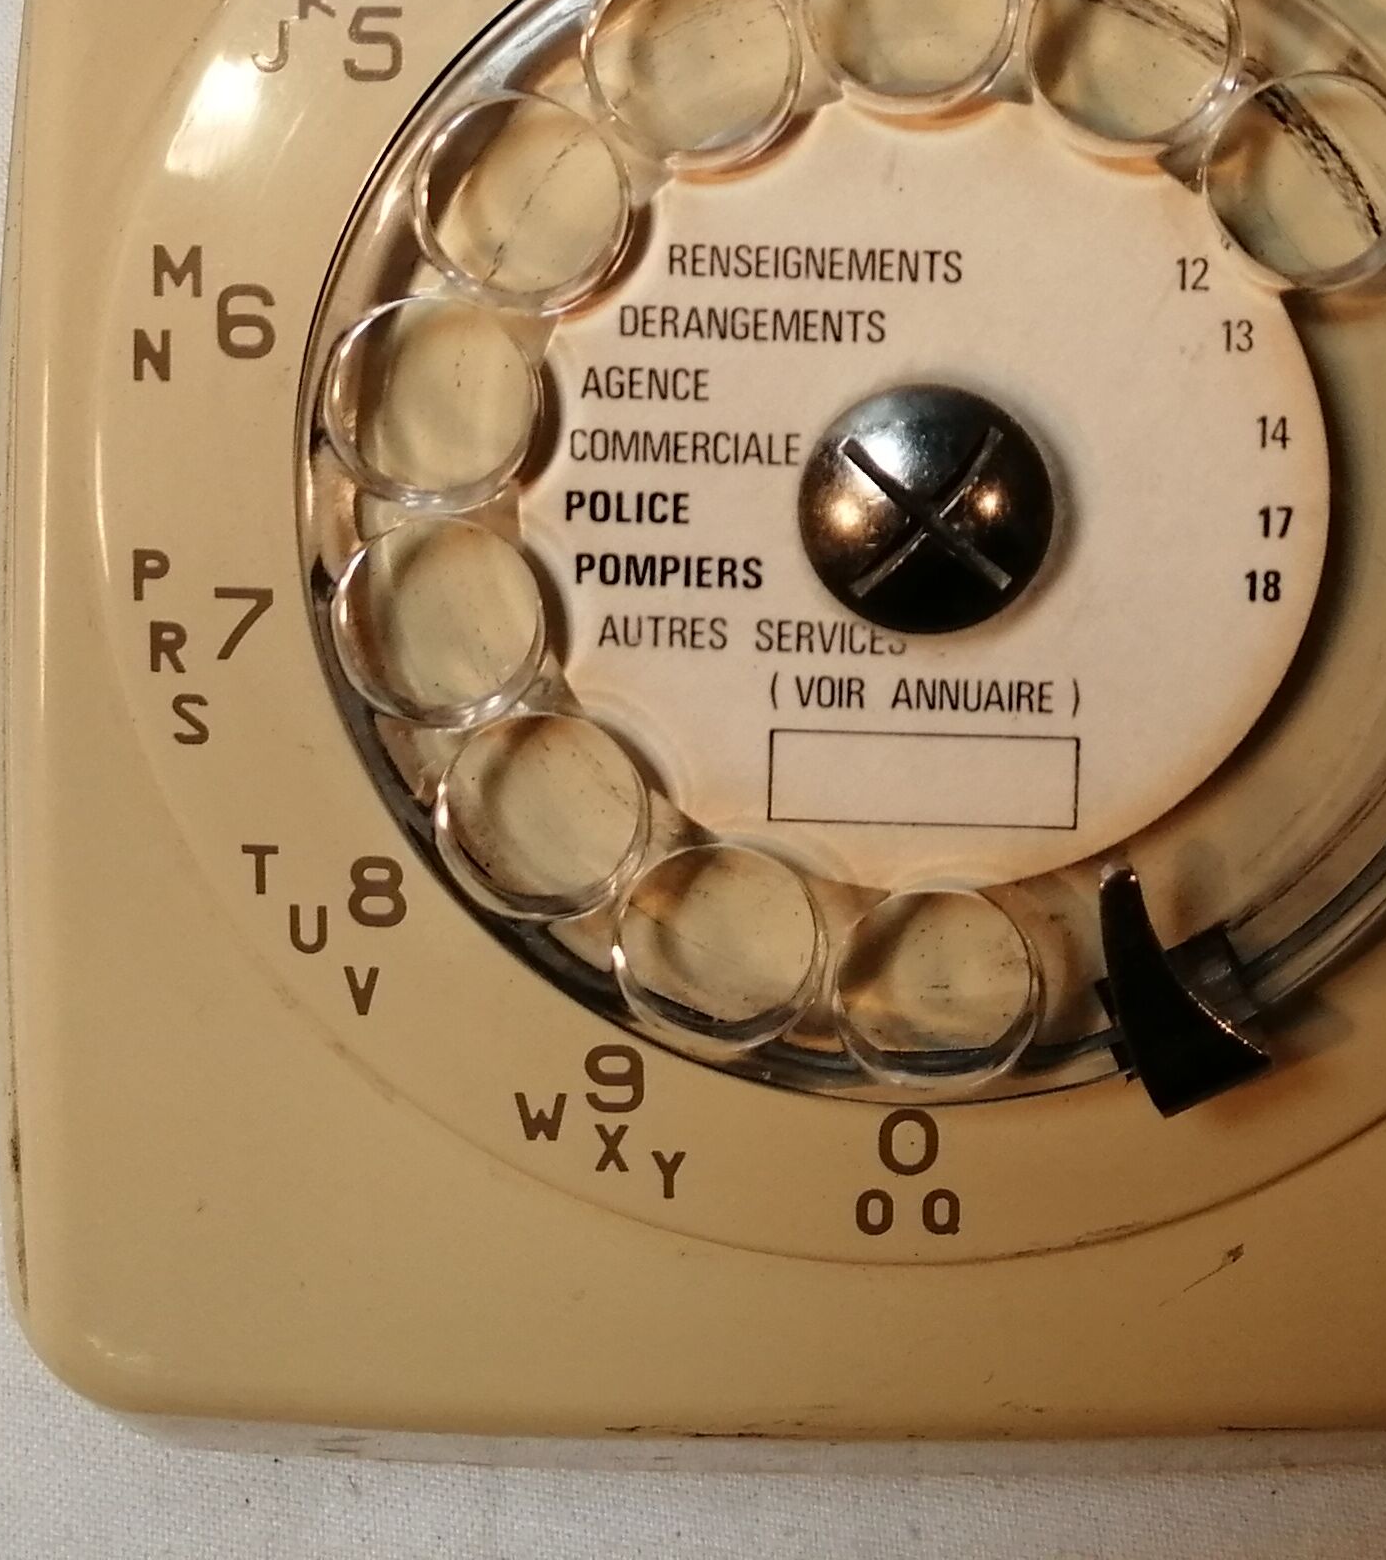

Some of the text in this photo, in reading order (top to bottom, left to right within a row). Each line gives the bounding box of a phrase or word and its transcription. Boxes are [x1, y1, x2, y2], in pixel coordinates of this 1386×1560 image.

[342, 6, 403, 83] 5
[667, 243, 964, 285] RENSEIGNEMENTS
[1175, 256, 1210, 292] 12
[215, 283, 276, 360] 6
[618, 304, 887, 345] DERANGEMENTS
[1221, 318, 1255, 354] 13
[580, 364, 710, 402] AGENCE
[569, 427, 801, 468] COMMERCIALE
[1256, 414, 1292, 451] 14
[564, 489, 691, 526] POLICE
[1257, 505, 1294, 541] 17
[574, 552, 764, 591] POMPIERS
[1244, 568, 1282, 604] 18
[213, 585, 275, 661] 7
[597, 613, 729, 651] AUTRES
[347, 855, 408, 928] 8
[584, 1044, 646, 1115] 9
